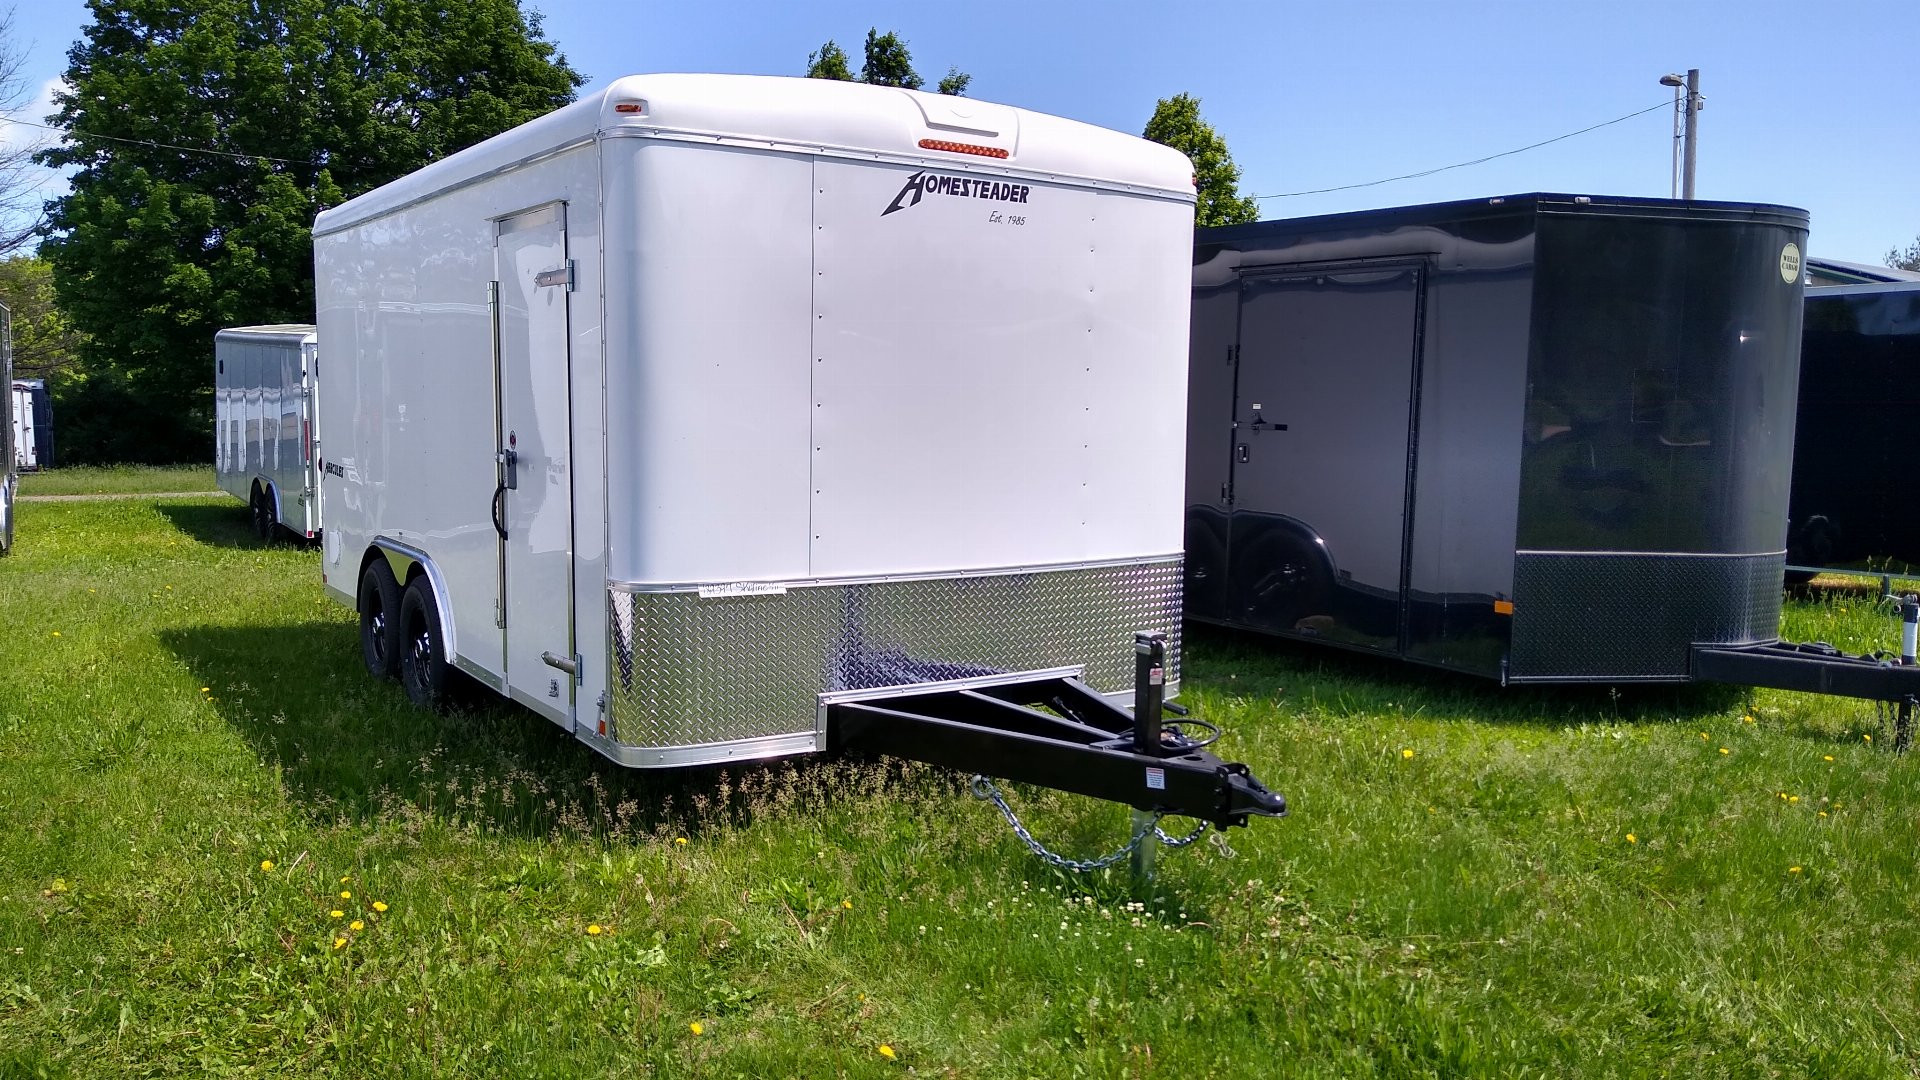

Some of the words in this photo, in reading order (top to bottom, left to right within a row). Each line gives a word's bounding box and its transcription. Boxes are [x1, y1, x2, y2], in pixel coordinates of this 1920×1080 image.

[880, 170, 1030, 217] HOMESTEADER
[989, 210, 1003, 225] Est.
[1007, 215, 1026, 226] 1985
[1782, 254, 1798, 264] WELLS
